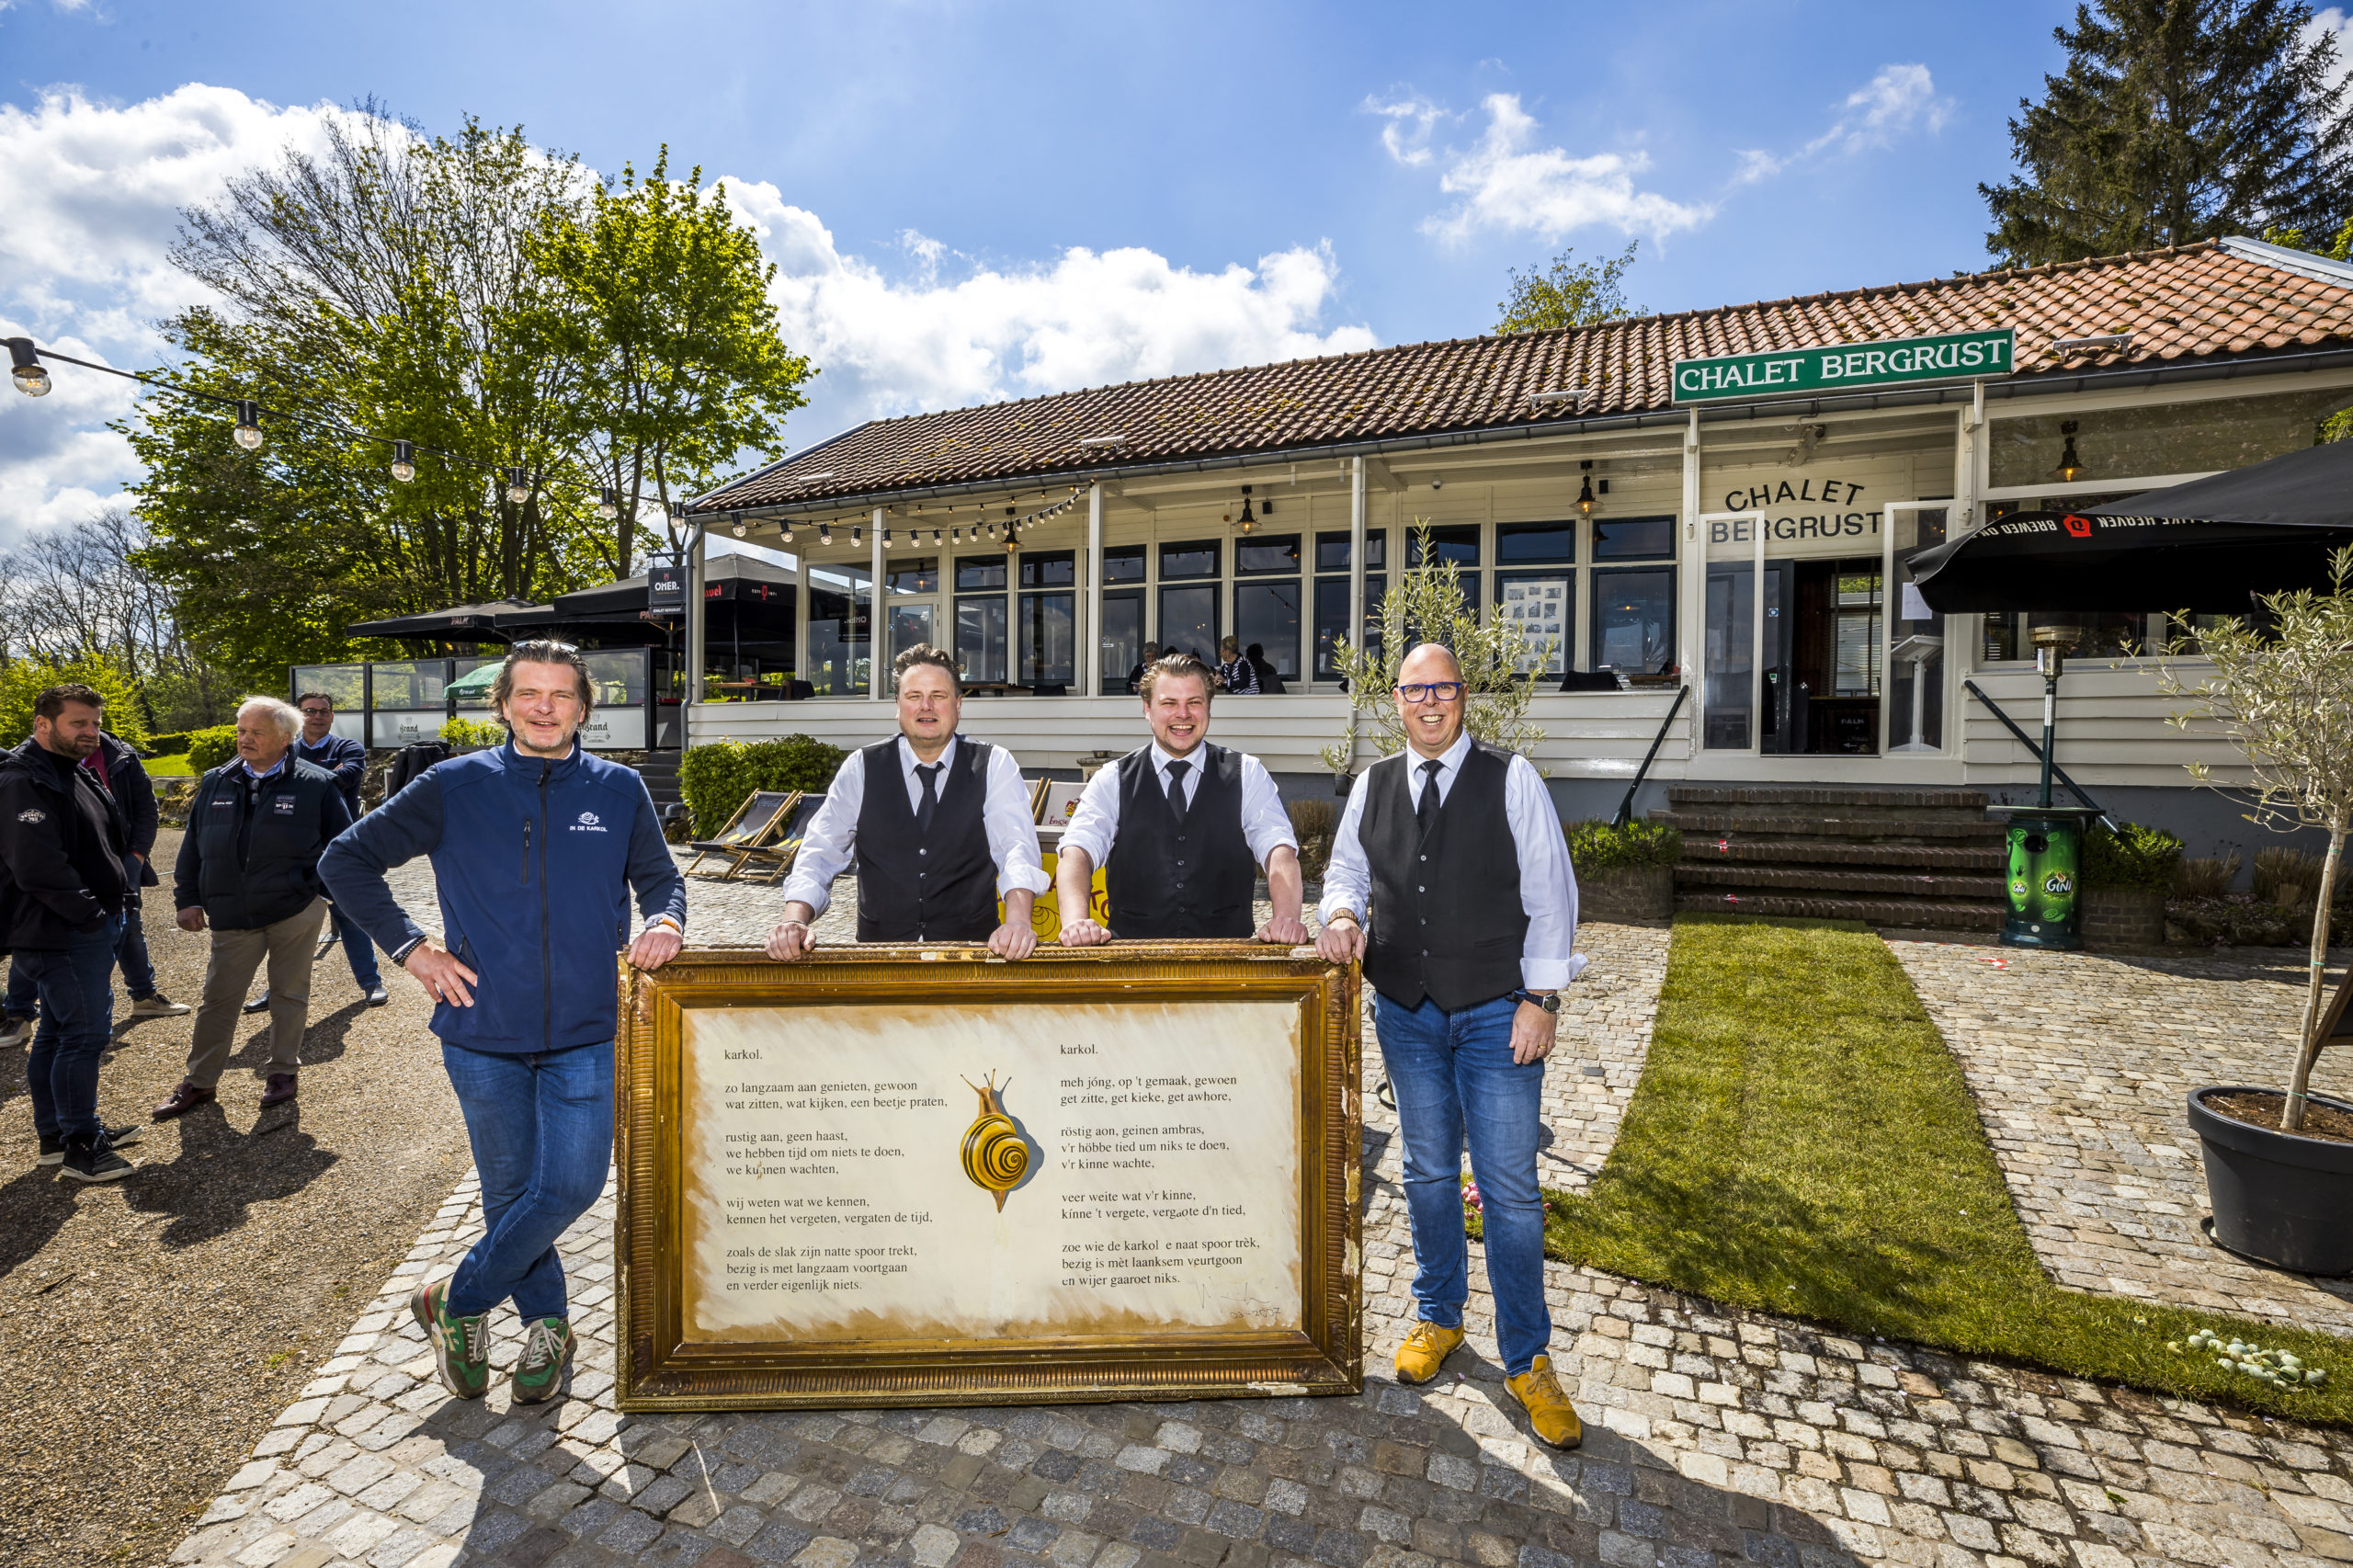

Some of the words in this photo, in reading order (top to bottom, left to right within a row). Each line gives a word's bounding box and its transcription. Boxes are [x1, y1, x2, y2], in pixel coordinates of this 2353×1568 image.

[1679, 358, 1804, 392] CHALET
[1820, 338, 2008, 380] BERGRUST
[1725, 479, 1865, 512] CHALET
[1711, 512, 1883, 543] BERGRUST
[2000, 520, 2058, 534] BREWED
[654, 581, 680, 591] OMER.
[704, 584, 722, 597] uvel
[399, 722, 418, 733] Brand
[2046, 878, 2072, 892] GINI
[724, 1049, 763, 1060] karkol.
[1060, 1043, 1098, 1055] karkol.
[724, 1085, 738, 1094] zo
[741, 1082, 794, 1096] langzaam
[797, 1084, 817, 1093] aan
[820, 1081, 870, 1095] genieten,
[873, 1082, 917, 1094] gewoon
[1060, 1076, 1084, 1087] meh
[1086, 1076, 1116, 1090] jóng,
[1118, 1078, 1132, 1090] op
[1135, 1075, 1142, 1086] 't
[1145, 1074, 1191, 1089] gemaak,
[1194, 1076, 1237, 1088] gewoen
[725, 1100, 745, 1109] wat
[748, 1097, 783, 1109] zitten,
[786, 1099, 806, 1108] wat
[809, 1097, 847, 1111] kijken,
[850, 1099, 870, 1108] een
[873, 1096, 906, 1110] beetje
[910, 1097, 948, 1110] praten,
[1060, 1095, 1077, 1107] get
[1080, 1093, 1109, 1104] zitte,
[1110, 1094, 1129, 1107] get
[1131, 1092, 1165, 1103] kieke,
[1167, 1093, 1185, 1105] get
[1188, 1091, 1232, 1102] awhore,
[725, 1131, 757, 1145] rustig
[760, 1133, 783, 1142] aan,
[786, 1133, 813, 1144] geen
[815, 1131, 848, 1142] haast,
[1061, 1125, 1093, 1140] röstig
[1095, 1128, 1119, 1137] aon,
[1121, 1124, 1159, 1139] geinen
[1162, 1124, 1205, 1135] ambras,
[725, 1151, 742, 1159] we
[745, 1147, 785, 1159] hebben
[788, 1147, 807, 1161] tijd
[810, 1150, 828, 1158] om
[831, 1146, 858, 1157] niets
[860, 1148, 871, 1157] te
[873, 1146, 904, 1157] doen,
[1061, 1142, 1075, 1153] v'r
[1078, 1142, 1112, 1153] höbbe
[1115, 1141, 1136, 1153] tied
[1139, 1143, 1156, 1152] um
[1160, 1140, 1183, 1152] niks
[1186, 1142, 1197, 1151] te
[1199, 1140, 1230, 1151] doen,
[725, 1167, 742, 1176] we
[790, 1163, 839, 1175] wachten,
[1061, 1159, 1075, 1170] v'r
[1078, 1158, 1109, 1169] kinne
[1112, 1157, 1154, 1169] wachte,
[726, 1197, 744, 1211] wij
[747, 1199, 780, 1208] weten
[783, 1199, 803, 1208] wat
[807, 1199, 824, 1207] we
[826, 1196, 870, 1207] kennen,
[1062, 1194, 1086, 1203] veer
[1088, 1190, 1119, 1202] weite
[1121, 1191, 1142, 1201] wat
[1144, 1190, 1160, 1201] v'r
[1162, 1189, 1196, 1201] kinne,
[726, 1213, 767, 1225] kennen
[769, 1213, 787, 1224] het
[790, 1214, 841, 1227] vergeten,
[844, 1213, 891, 1226] vergaten
[893, 1211, 907, 1222] de
[911, 1211, 933, 1225] tijd,
[1095, 1208, 1102, 1219] 't
[1105, 1209, 1149, 1221] vergete,
[1201, 1205, 1219, 1216] d'n
[1222, 1204, 1246, 1216] tied,
[726, 1246, 756, 1257] zoals
[757, 1246, 771, 1257] de
[774, 1245, 796, 1257] slak
[800, 1245, 821, 1260] zijn
[824, 1247, 851, 1256] natte
[854, 1248, 886, 1259] spoor
[888, 1244, 917, 1256] trekt,
[1062, 1244, 1081, 1253] zoe
[1085, 1241, 1105, 1252] wie
[1107, 1240, 1121, 1252] de
[1124, 1239, 1159, 1251] karkol
[1175, 1240, 1199, 1250] naat
[1201, 1240, 1233, 1252] spoor
[726, 1263, 757, 1277] bezig
[760, 1263, 769, 1274] is
[772, 1264, 793, 1274] met
[796, 1262, 849, 1277] langzaam
[853, 1264, 907, 1276] voortgaan
[1062, 1257, 1092, 1272] bezig
[1096, 1257, 1105, 1268] is
[1131, 1256, 1184, 1267] laanksem
[1187, 1256, 1243, 1268] veurtgoon
[726, 1282, 740, 1291] en
[743, 1279, 779, 1290] verder
[780, 1278, 830, 1293] eigenlijk
[833, 1278, 862, 1290] niets.
[1062, 1278, 1075, 1286] en
[1078, 1274, 1108, 1289] wijer
[1154, 1272, 1180, 1284] niks.
